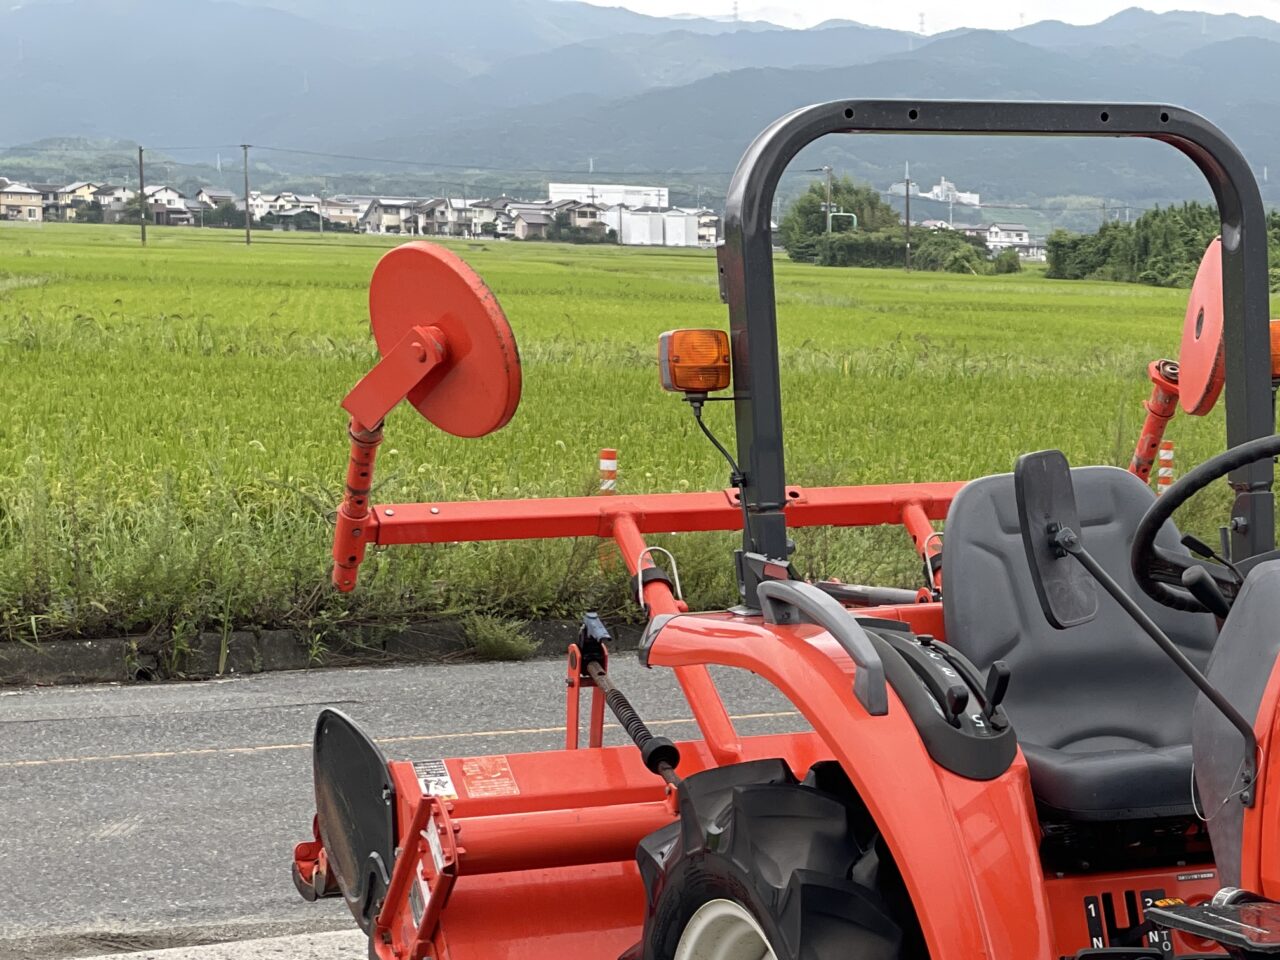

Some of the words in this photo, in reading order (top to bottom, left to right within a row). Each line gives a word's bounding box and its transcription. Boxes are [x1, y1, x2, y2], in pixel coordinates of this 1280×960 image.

[1088, 903, 1096, 917] 1
[1092, 937, 1104, 949] N
[1148, 931, 1159, 943] N
